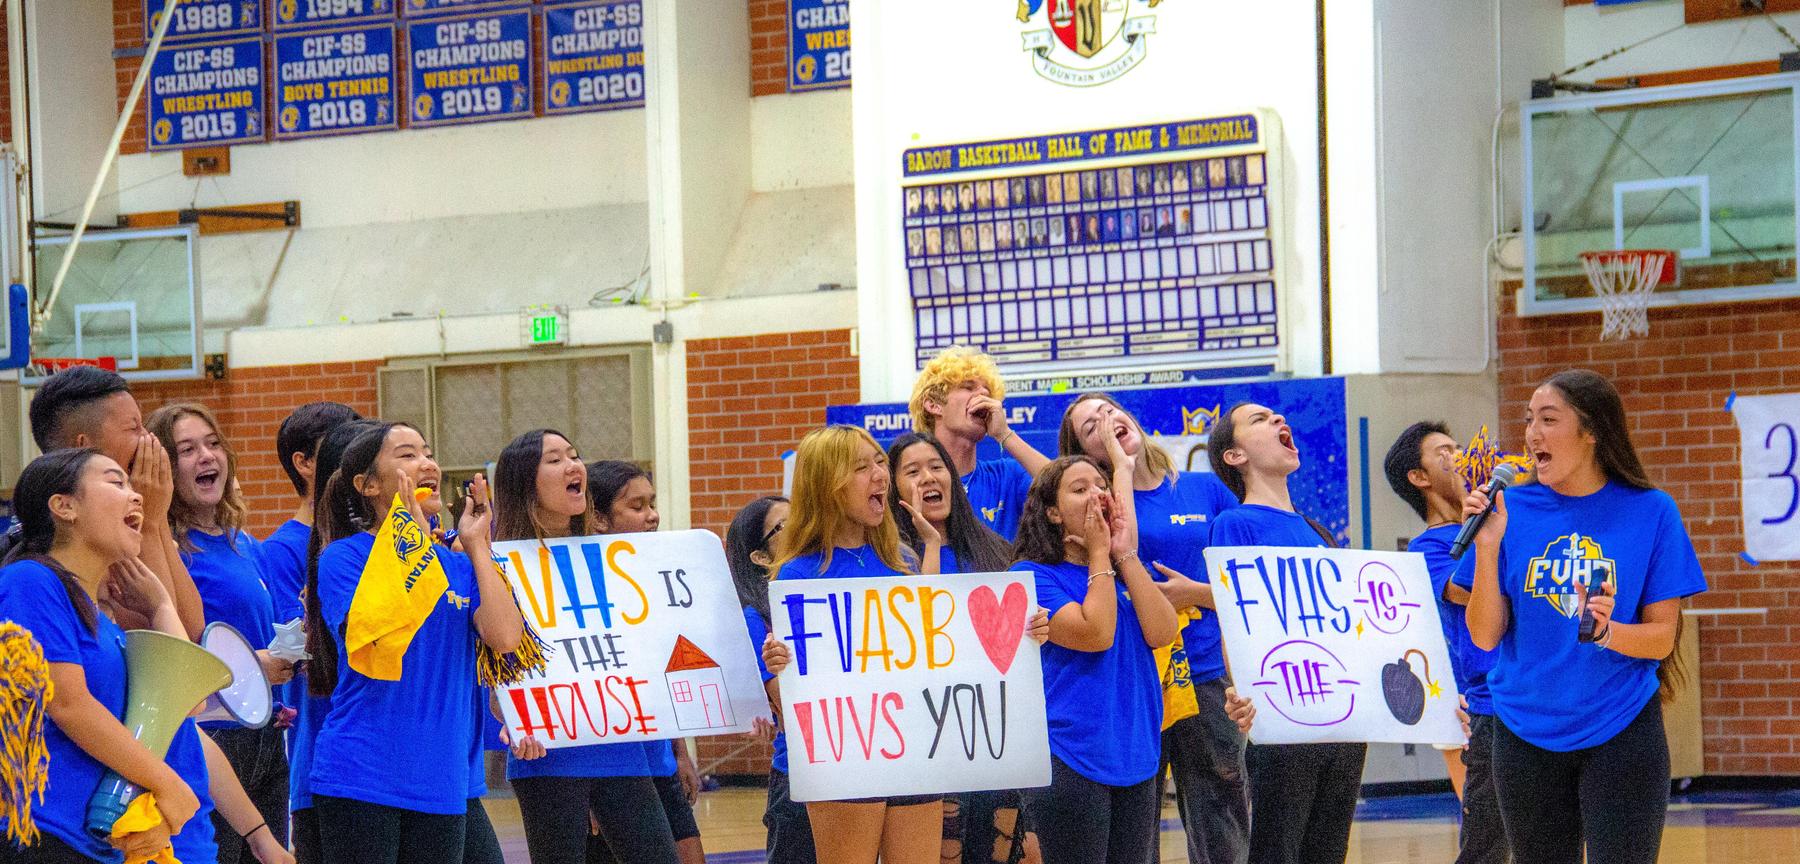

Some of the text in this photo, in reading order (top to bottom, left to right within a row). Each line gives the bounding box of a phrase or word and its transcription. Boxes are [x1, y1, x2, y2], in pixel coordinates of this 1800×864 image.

[174, 3, 233, 32] 1988
[574, 3, 641, 31] CIF-SS
[303, 33, 366, 59] CIF-SS
[435, 18, 502, 46] CIF-SS
[552, 25, 644, 55] CHAMPIO
[173, 46, 235, 73] CIF-SS
[281, 53, 390, 82] CHAMPIONS
[415, 40, 525, 69] CHAMPIONS
[549, 54, 624, 75] WRESTLING
[1043, 55, 1134, 83] FOUNTAIN VALLEY
[154, 66, 258, 95] CHAMPIONS
[283, 77, 389, 102] BOYS TENNIS
[423, 64, 520, 90] WRESTLING
[578, 72, 643, 102] 2020
[162, 90, 253, 115] WRESTLING
[307, 99, 368, 128] 2018
[441, 86, 502, 116] 2019
[180, 111, 236, 140] 2015
[907, 119, 1253, 173] BARON BASKETBALL HALL OF FAME & MEMORIAL
[533, 317, 556, 342] EXIT
[1077, 373, 1146, 389] SCHOLARSHIP
[1149, 371, 1185, 384] AWARD
[1761, 423, 1800, 525] 3
[491, 541, 693, 628] VHS IS
[1226, 556, 1398, 637] FVHS IS
[781, 585, 955, 676] FVASB
[553, 633, 628, 673] THE
[1271, 659, 1334, 707] THE
[508, 675, 658, 740] HOUSE
[793, 680, 1007, 764] LUVS YOU
